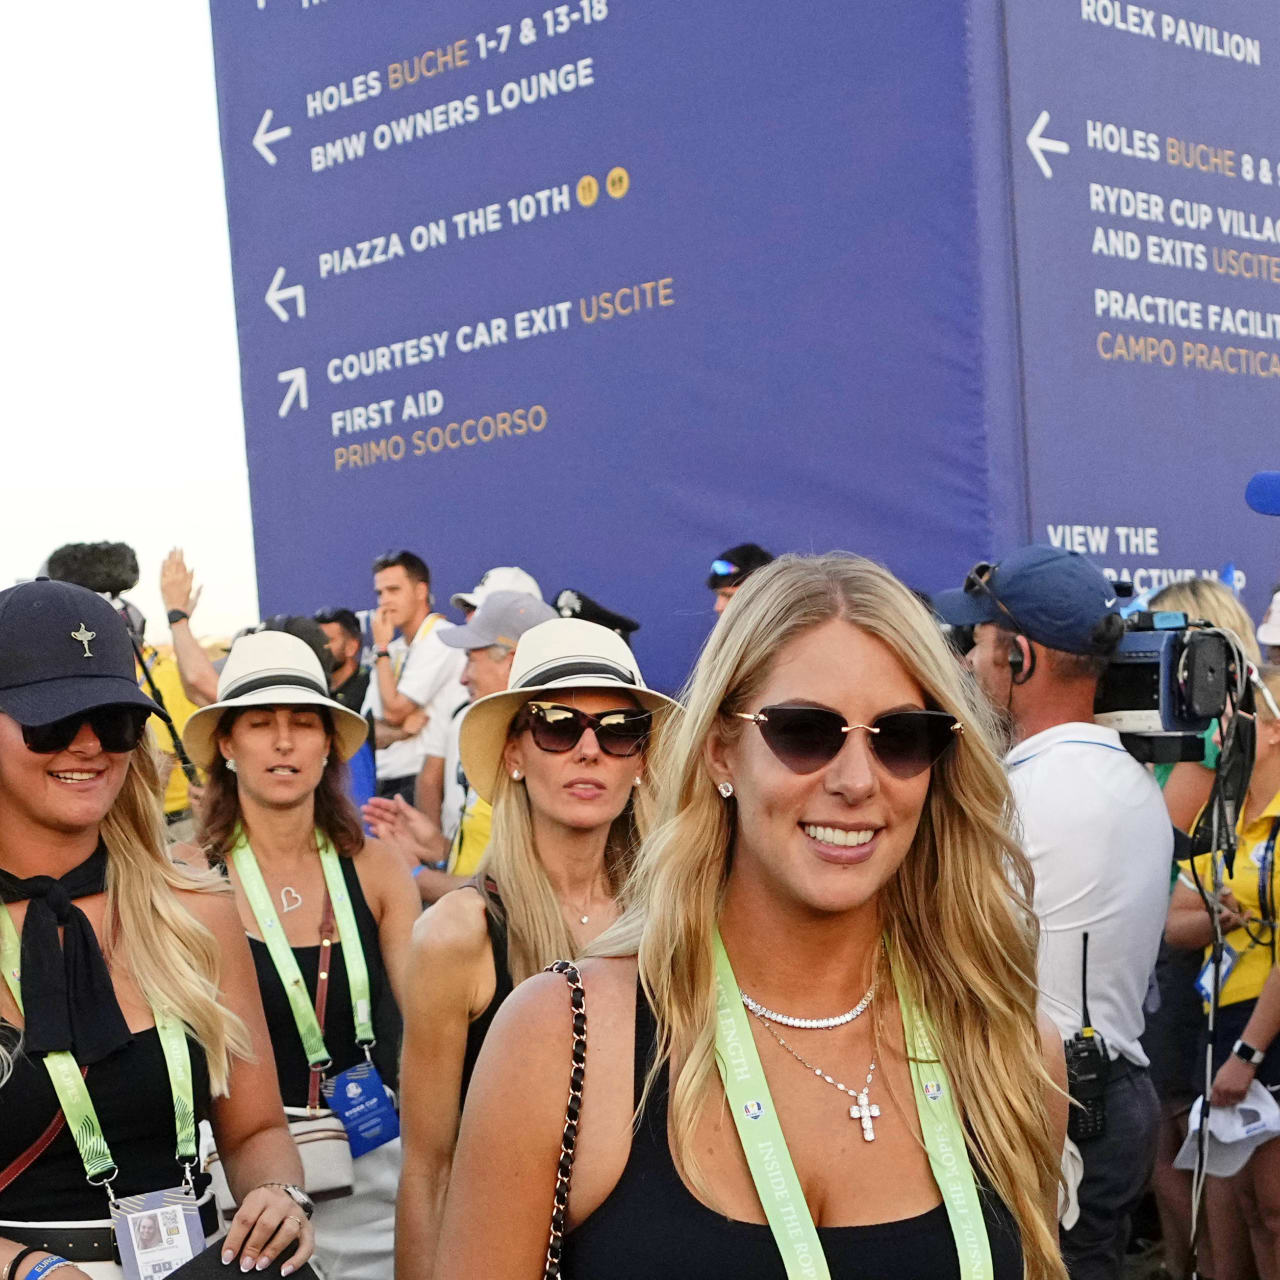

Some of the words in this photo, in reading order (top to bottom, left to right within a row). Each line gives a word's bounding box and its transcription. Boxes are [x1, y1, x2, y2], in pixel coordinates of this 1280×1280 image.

[306, 70, 382, 118] HOLES
[388, 39, 469, 90] BUCHE
[475, 24, 512, 60] 1-7
[519, 17, 537, 46] &
[542, 0, 609, 37] 13-18
[1081, 0, 1156, 38] ROLEX
[1161, 14, 1261, 66] PAVILION
[310, 131, 366, 172] BMW
[373, 94, 480, 150] OWNERS
[486, 57, 595, 115] LOUNGE
[1086, 119, 1160, 162] HOLES
[1166, 136, 1237, 178] BUCHE
[1241, 153, 1255, 181] 8
[1258, 157, 1273, 185] &
[319, 232, 405, 279] PIAZZA
[410, 219, 448, 252] ON
[452, 203, 503, 240] THE
[507, 183, 571, 225] 10TH
[1089, 182, 1166, 223] RYDER
[1169, 198, 1213, 230] CUP
[1091, 226, 1141, 260] AND
[1146, 235, 1208, 272] EXITS
[327, 330, 450, 385] COURTESY
[455, 317, 508, 353] CAR
[514, 301, 573, 340] EXIT
[579, 277, 675, 324] USCITE
[1094, 287, 1204, 330] PRACTICE
[1096, 330, 1177, 367] CAMPO
[331, 399, 395, 437] FIRST
[401, 388, 444, 422] AID
[333, 434, 406, 472] PRIMO
[411, 404, 548, 457] SOCCORSO
[1047, 524, 1109, 555] VIEW
[1115, 526, 1160, 556] THE
[719, 1008, 752, 1082] LENGTH
[758, 1141, 790, 1201] INSIDE
[780, 1203, 804, 1240] THE
